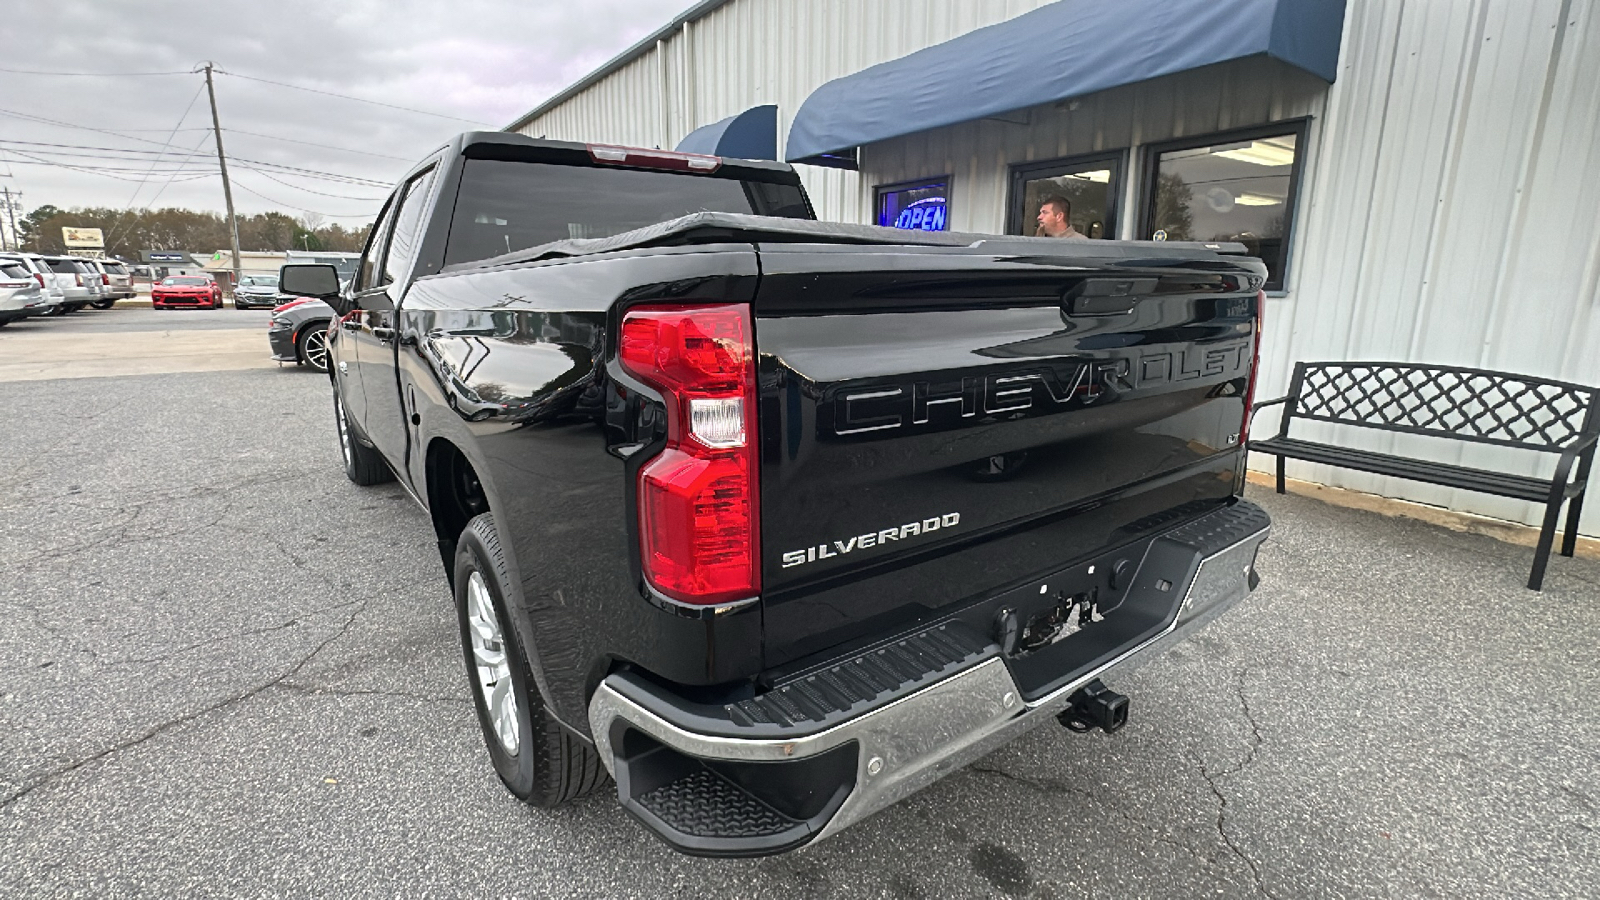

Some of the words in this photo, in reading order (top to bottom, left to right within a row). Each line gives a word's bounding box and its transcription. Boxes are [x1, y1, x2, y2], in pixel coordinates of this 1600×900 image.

[897, 205, 947, 231] OPEN
[834, 341, 1249, 436] CHEVROLET
[1227, 433, 1240, 444] LT
[782, 512, 961, 568] SILVERADO
